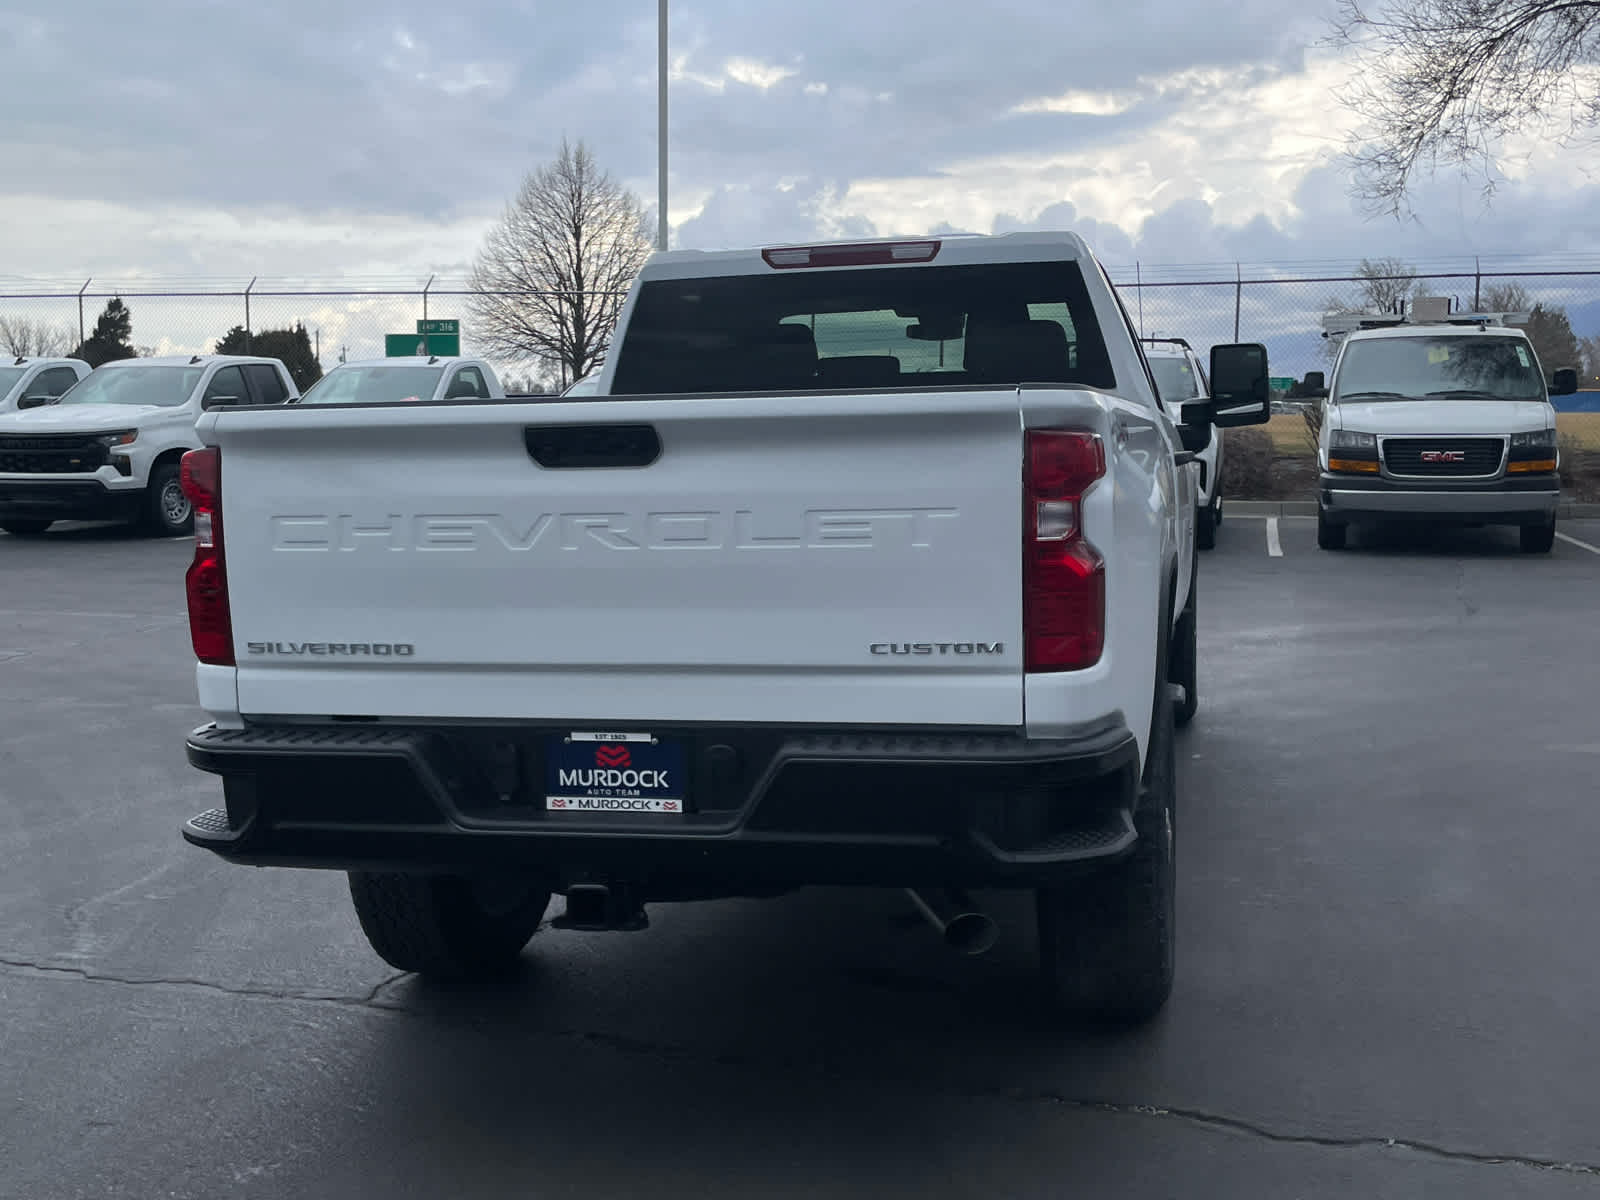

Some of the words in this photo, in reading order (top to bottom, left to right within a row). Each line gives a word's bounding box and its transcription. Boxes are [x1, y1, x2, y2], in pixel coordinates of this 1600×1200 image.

[440, 322, 454, 331] 316
[1421, 451, 1464, 462] GMC
[271, 508, 959, 551] CHEVROLET
[247, 642, 413, 656] SILVERADO
[870, 642, 1004, 654] CUSTOM
[559, 769, 669, 788] MURDOCK
[578, 799, 652, 810] MURDOCK
